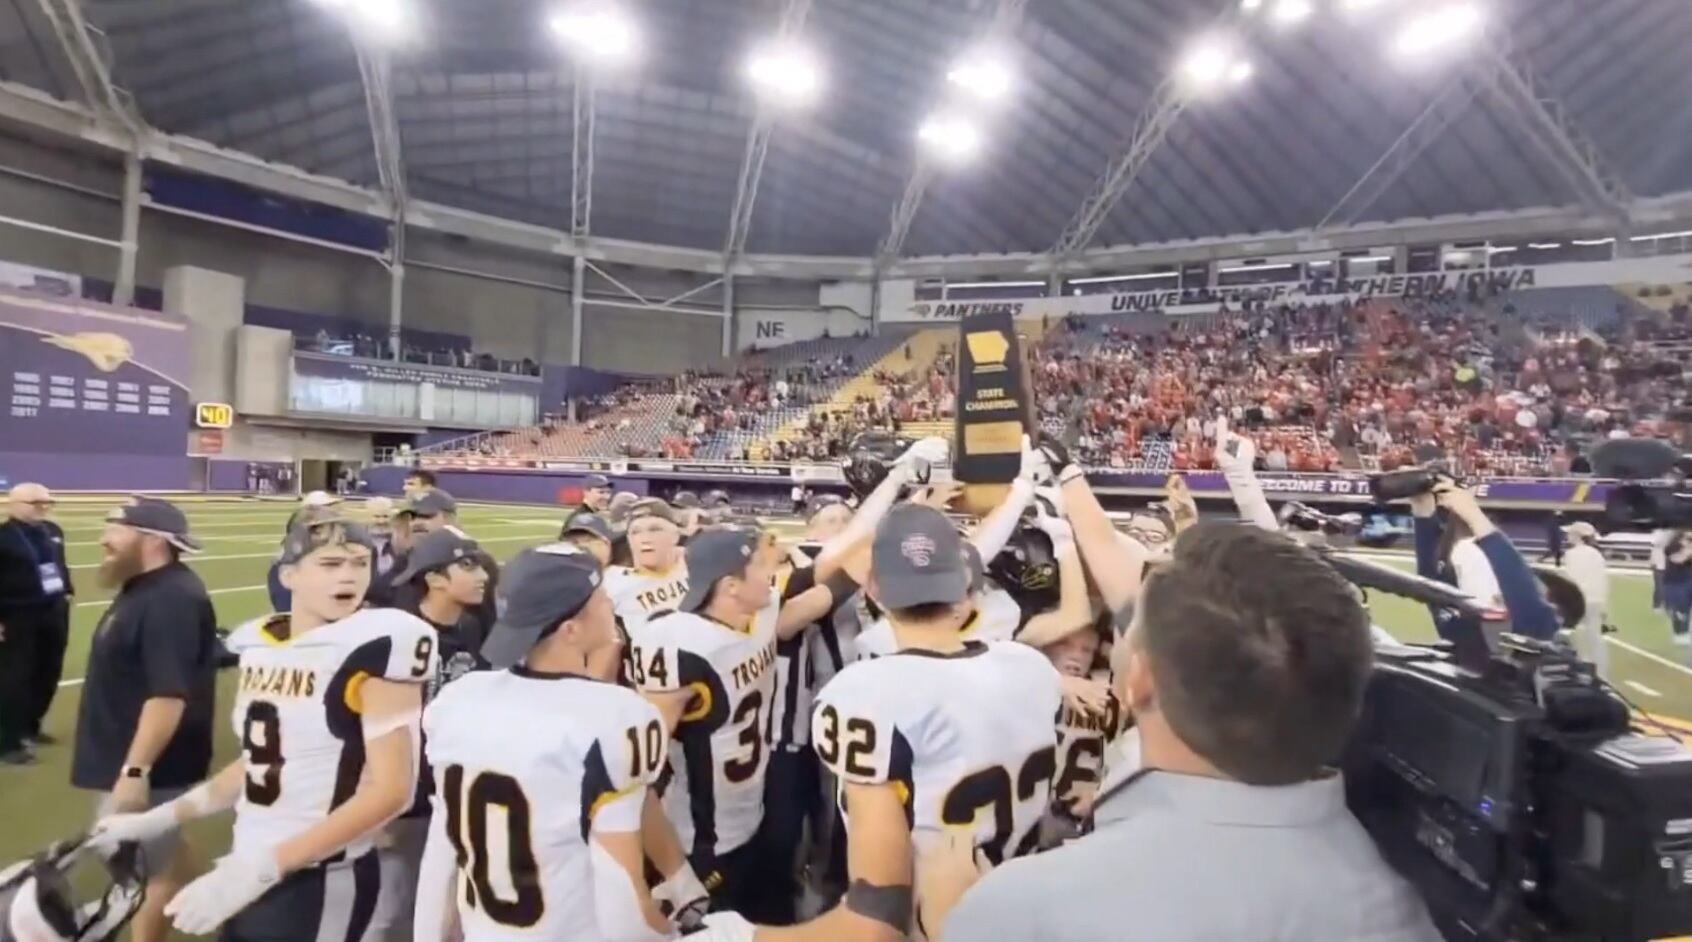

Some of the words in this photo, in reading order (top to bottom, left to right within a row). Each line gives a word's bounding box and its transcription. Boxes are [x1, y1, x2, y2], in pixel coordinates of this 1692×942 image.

[202, 407, 227, 424] 40
[636, 579, 691, 611] TROJA
[411, 636, 434, 677] 9
[633, 646, 668, 687] 34
[243, 700, 286, 808] 9
[627, 719, 663, 778] 10
[818, 704, 878, 777] 32
[444, 762, 546, 929] 10
